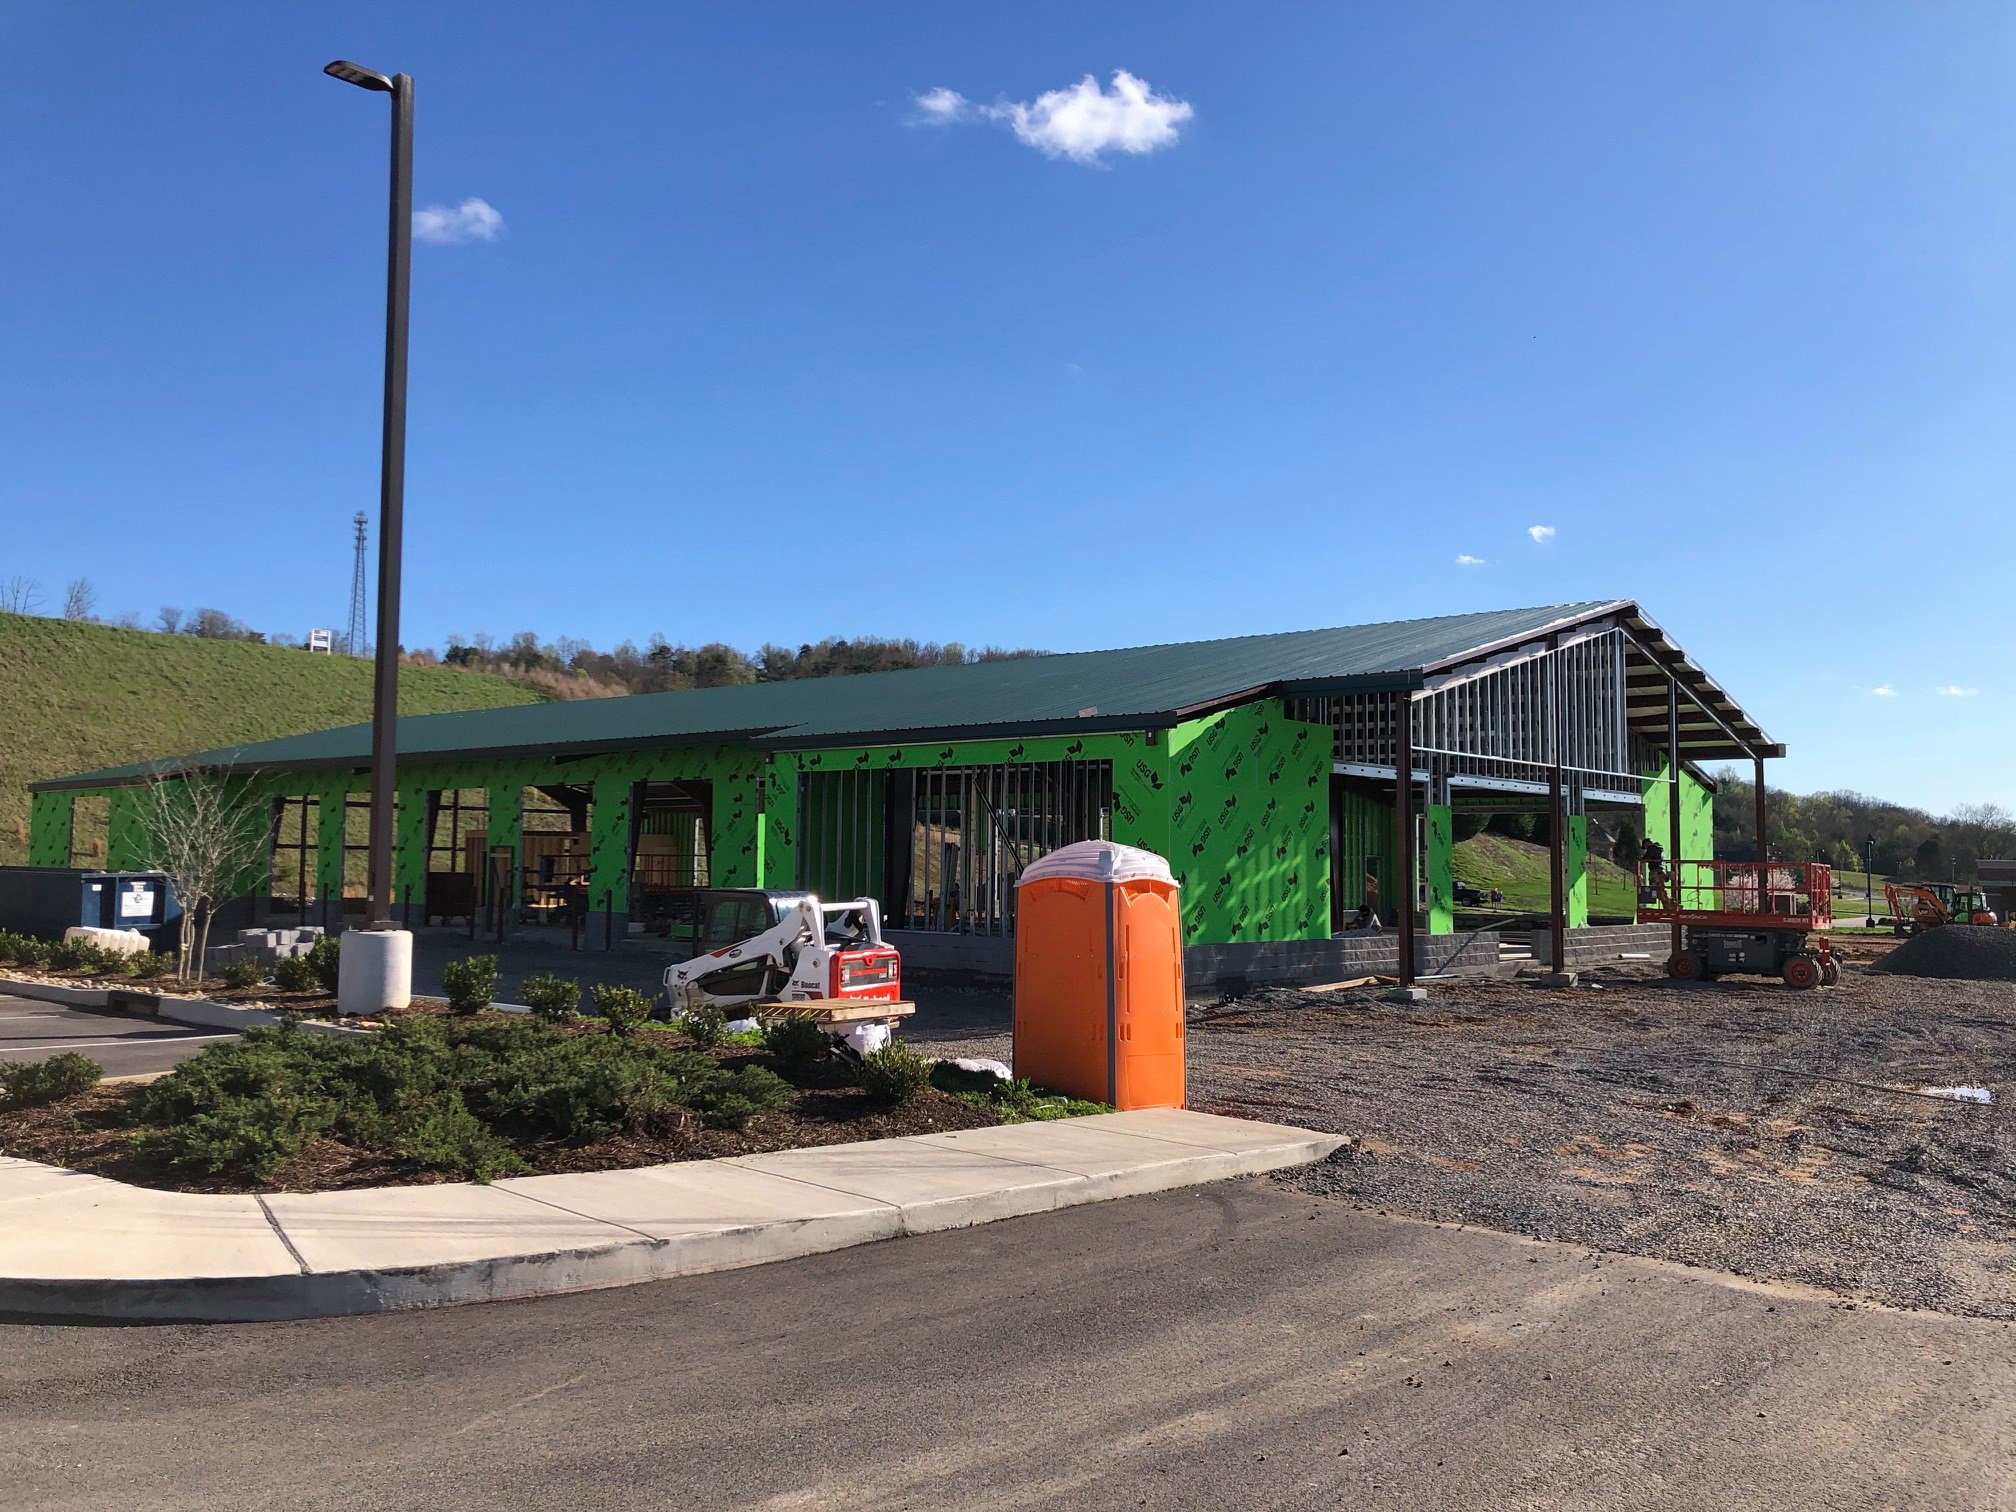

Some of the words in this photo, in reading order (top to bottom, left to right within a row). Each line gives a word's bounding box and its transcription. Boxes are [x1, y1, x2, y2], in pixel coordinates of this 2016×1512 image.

[1206, 729, 1218, 746] USG
[1250, 735, 1262, 751] USG
[1188, 747, 1200, 764] USG
[1233, 752, 1244, 768] USG
[1136, 759, 1151, 778] USG
[1276, 757, 1286, 772] USG
[1120, 806, 1135, 825] USG
[1172, 805, 1184, 822] USG
[1218, 807, 1230, 824] USG
[1261, 811, 1271, 827] USG
[775, 818, 786, 834] USG
[1200, 826, 1212, 844] USG
[1244, 829, 1255, 845] USG
[1282, 830, 1293, 847] USG
[1212, 885, 1224, 903] USG
[1281, 886, 1291, 902] USG
[1194, 906, 1206, 924] USG
[1238, 905, 1250, 923] USG
[1304, 904, 1315, 921] USG
[801, 981, 820, 989] Bobcat
